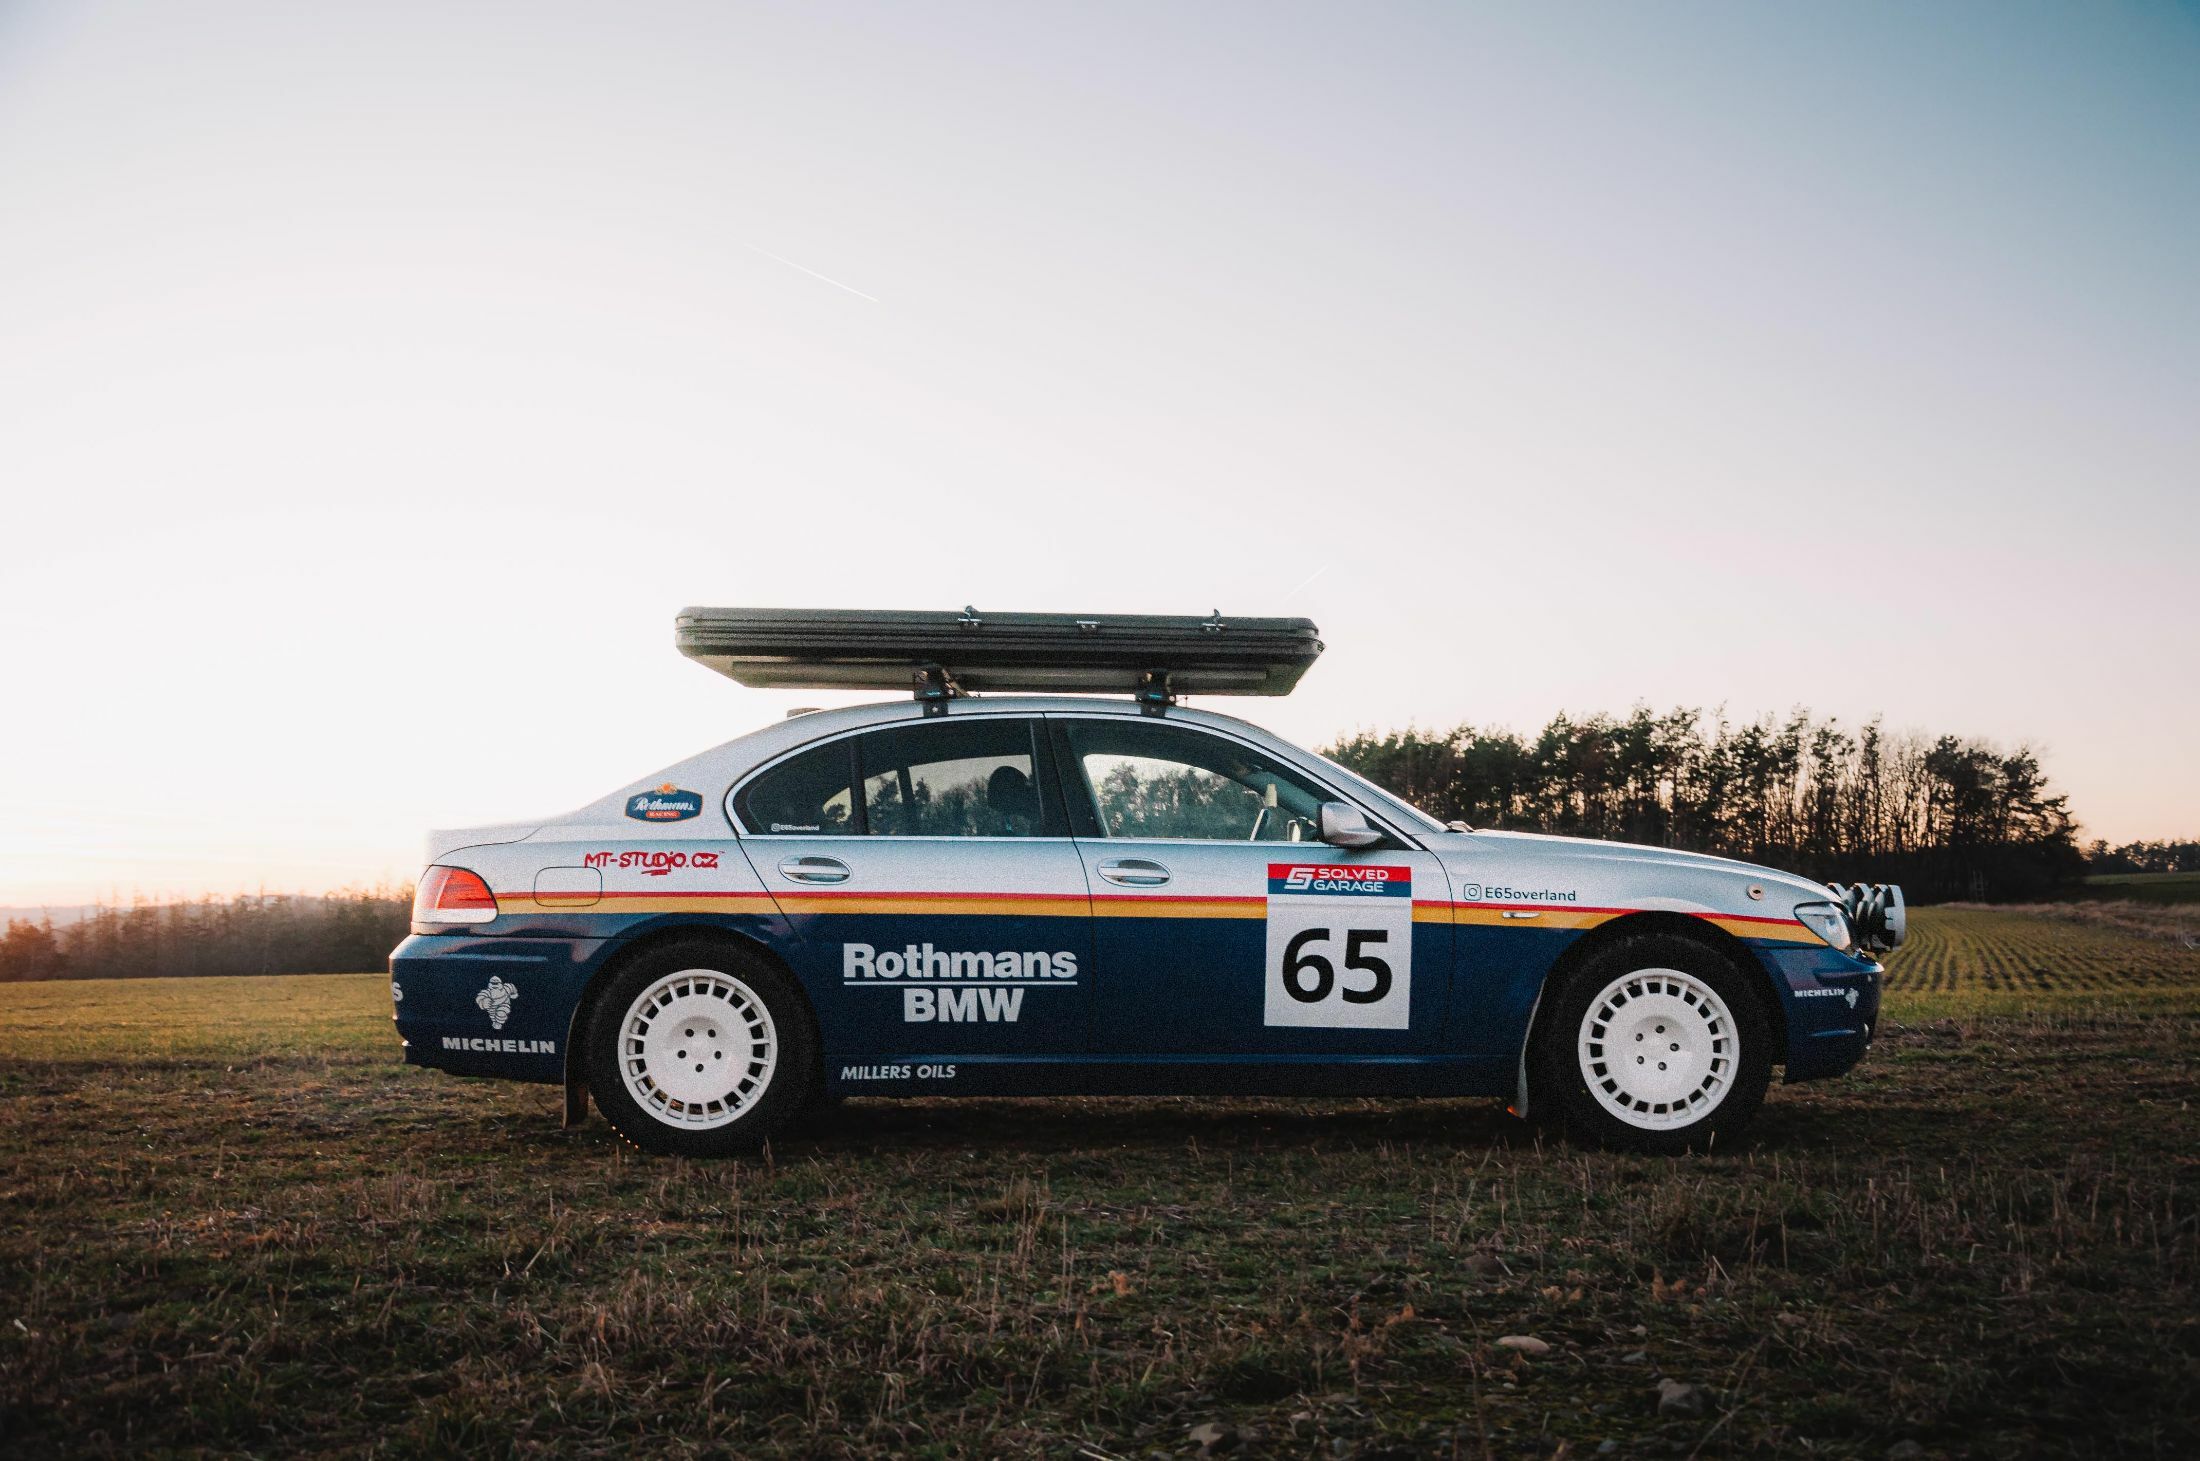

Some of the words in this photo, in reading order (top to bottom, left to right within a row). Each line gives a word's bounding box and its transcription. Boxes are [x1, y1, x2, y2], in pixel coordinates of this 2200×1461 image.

[1318, 868, 1389, 880] SOLVED
[1313, 879, 1385, 893] GARAGE
[1485, 887, 1577, 901] E65overland
[843, 942, 1078, 979] Rothmans
[1282, 927, 1393, 1004] 65
[1794, 988, 1845, 998] MICHELIN
[904, 988, 1025, 1023] BMW
[442, 1036, 556, 1054] MICHELIN
[840, 1065, 911, 1080] MILLERS
[916, 1064, 957, 1079] OILS
